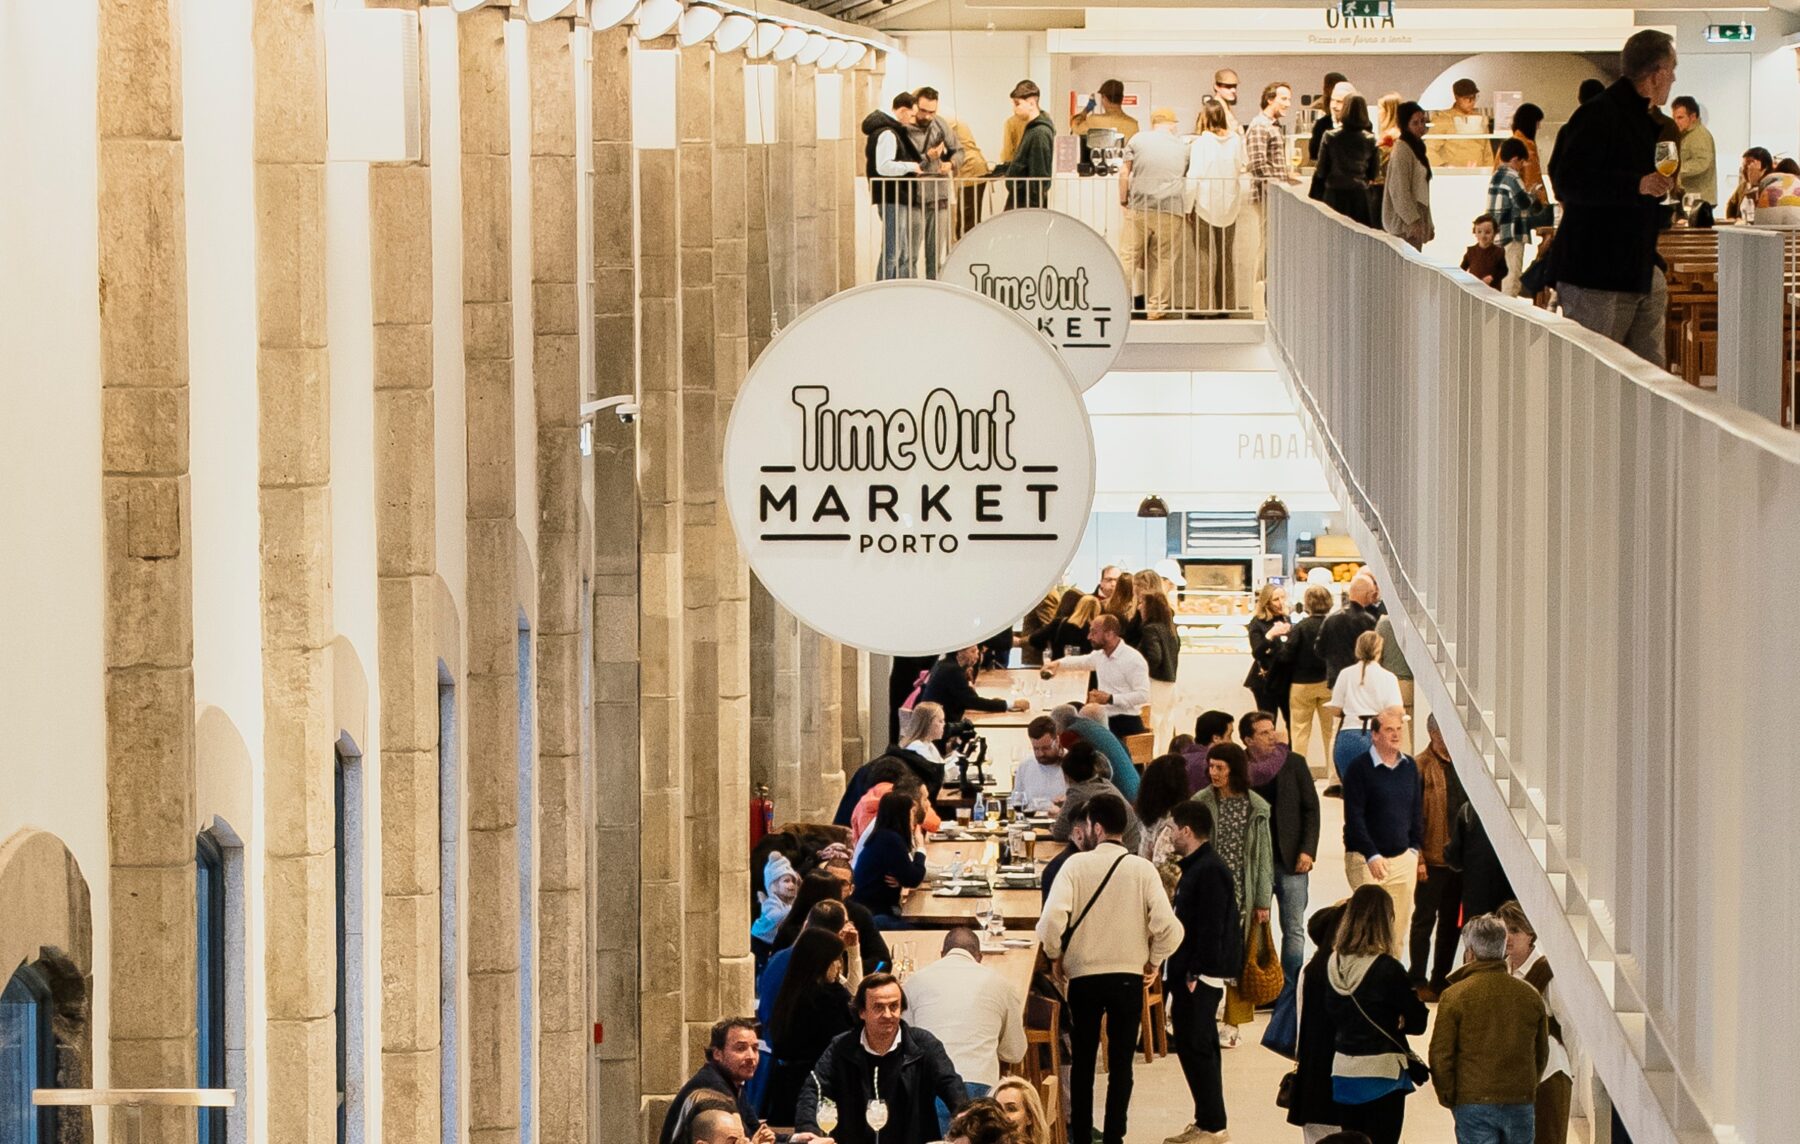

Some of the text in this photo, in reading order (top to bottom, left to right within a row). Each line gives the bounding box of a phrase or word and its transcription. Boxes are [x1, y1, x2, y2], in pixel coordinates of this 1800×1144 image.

[1038, 265, 1089, 310] Out
[1037, 317, 1111, 338] KET
[792, 385, 1016, 471] Time Out
[760, 484, 1058, 522] MARKET
[859, 533, 959, 554] PORTO
